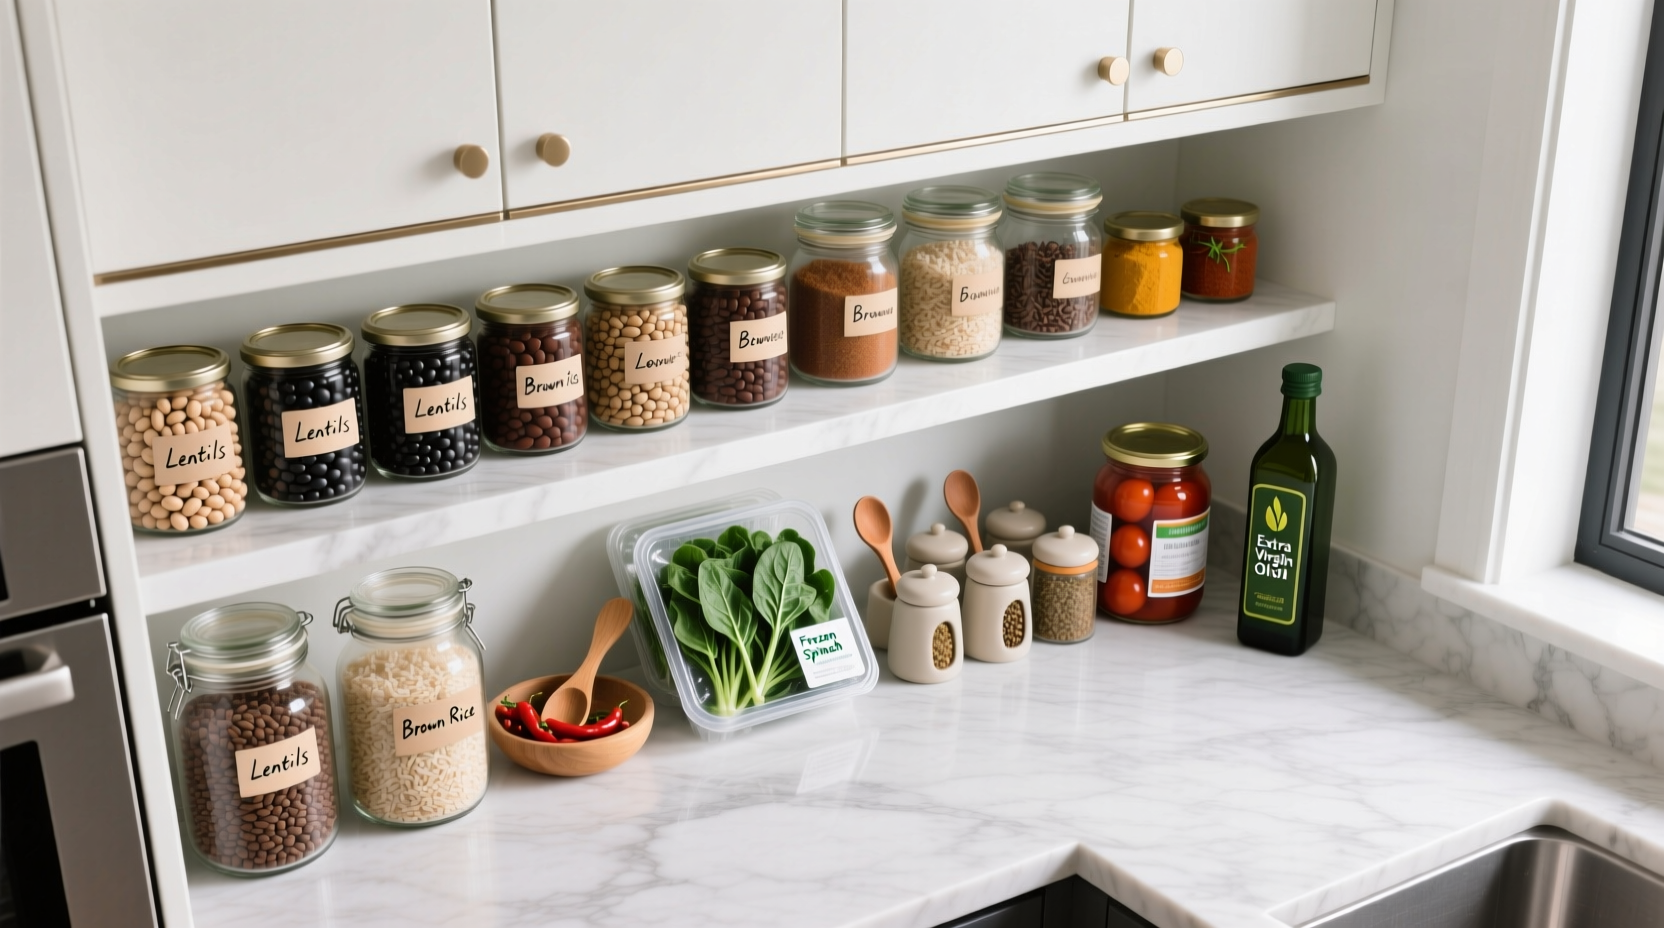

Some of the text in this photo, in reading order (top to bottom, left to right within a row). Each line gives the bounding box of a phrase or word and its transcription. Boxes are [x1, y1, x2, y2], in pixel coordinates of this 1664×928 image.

[414, 392, 468, 419] Lentils
[294, 417, 351, 443] Lentils
[165, 439, 226, 469] Lentils
[1256, 534, 1292, 553] Extra
[402, 705, 476, 740] Brown Rice
[250, 747, 309, 781] Lentils
